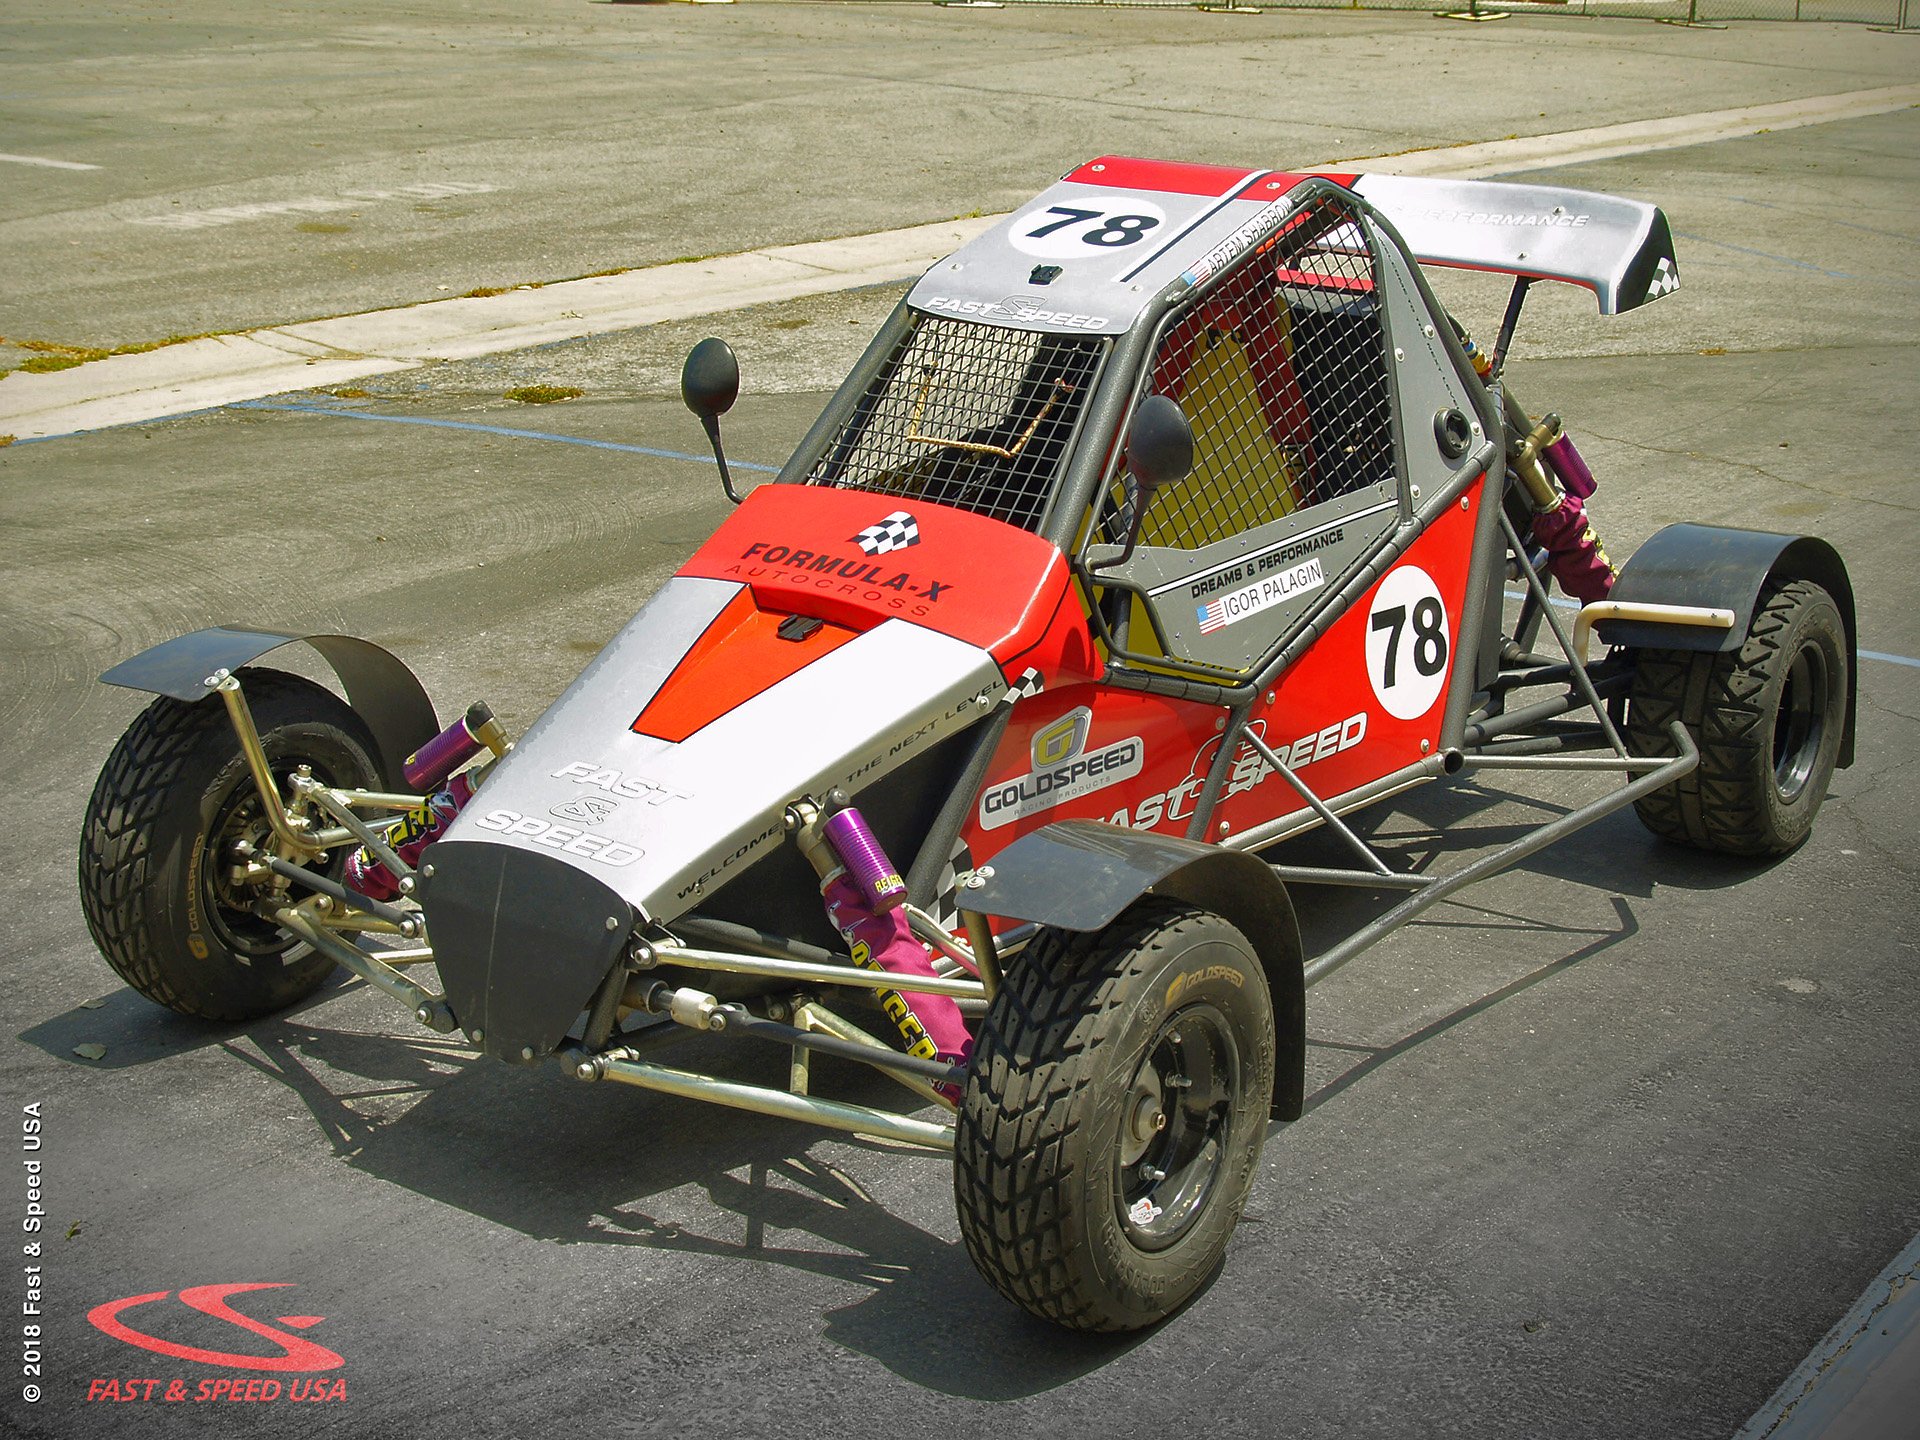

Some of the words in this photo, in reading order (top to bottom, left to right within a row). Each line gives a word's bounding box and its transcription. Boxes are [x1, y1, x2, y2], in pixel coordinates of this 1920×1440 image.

[1025, 206, 1160, 246] 78
[1207, 235, 1246, 275] ARTEM
[923, 297, 1003, 316] FAST
[1012, 307, 1109, 330] SPEED
[724, 564, 930, 617] AUTOCROSS
[740, 542, 954, 602] FORMULA-X
[1191, 569, 1243, 599] DREAMS
[1246, 562, 1256, 577] &
[1258, 528, 1344, 573] PERFORMANCE
[1223, 588, 1261, 618] IGOR
[1262, 541, 1322, 602] PALAGIN
[1372, 596, 1448, 690] 78
[551, 761, 695, 806] FAST
[677, 822, 781, 899] WELCOME
[845, 755, 882, 783] THE
[889, 718, 939, 757] NEXT
[944, 680, 1003, 721] LEVEL
[984, 742, 1137, 815] GOLDSPEED
[1014, 797, 1053, 817] RACING
[1058, 775, 1112, 800] PRODUCTS
[1095, 780, 1199, 832] AST
[1228, 711, 1368, 790] SPEED
[474, 809, 646, 868] SPEED
[187, 832, 205, 932] GOLDSPEED
[1184, 964, 1246, 991] GOLDSPEED
